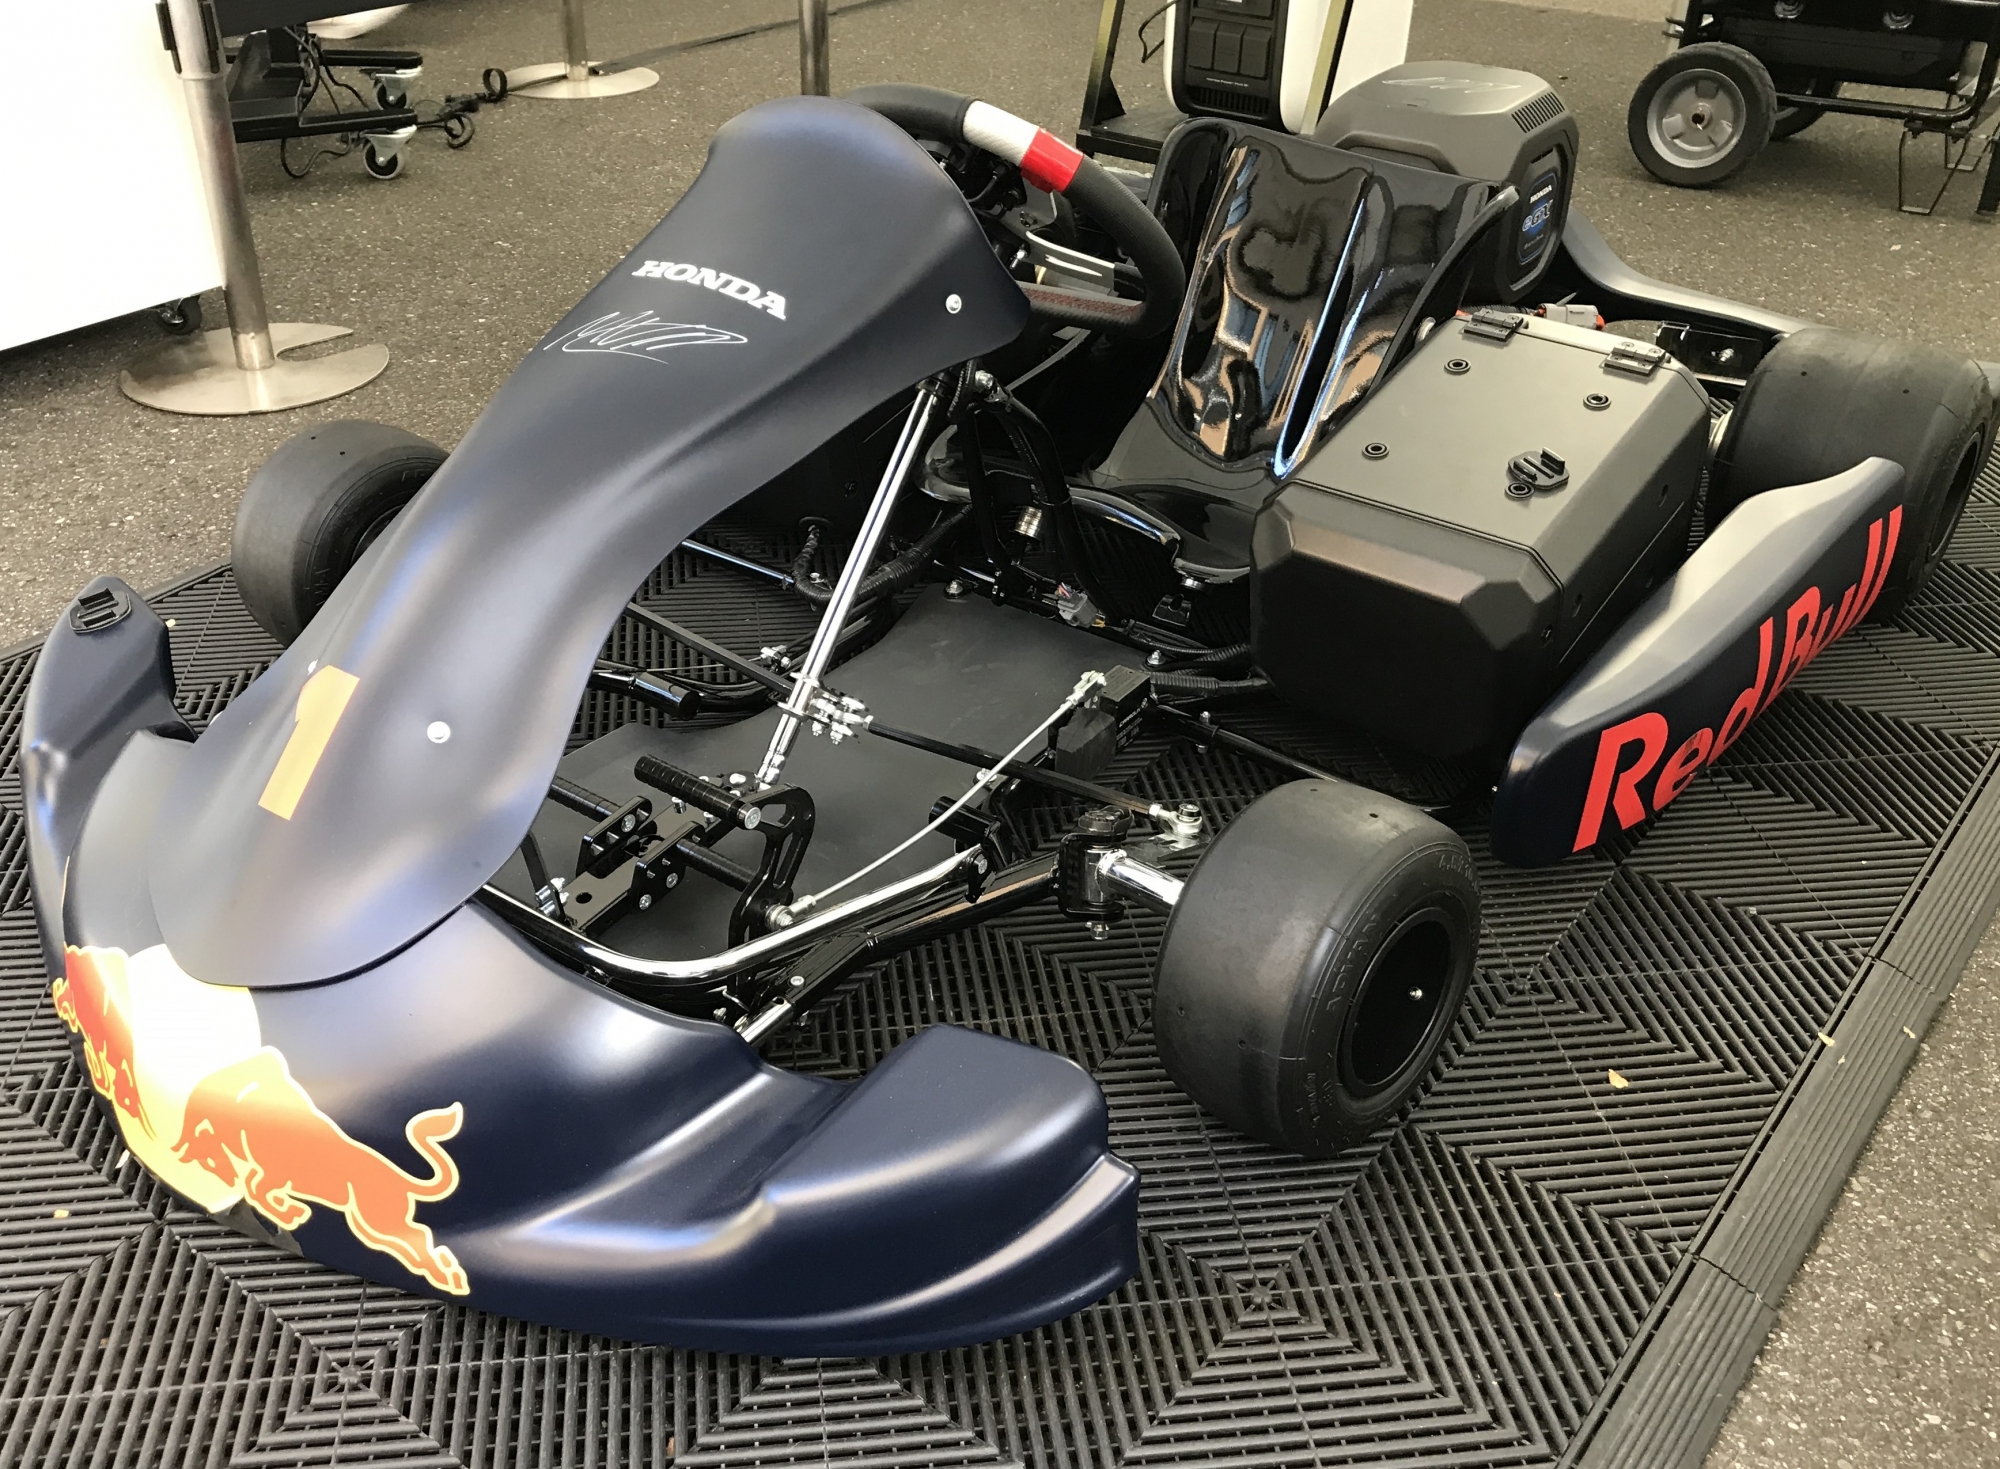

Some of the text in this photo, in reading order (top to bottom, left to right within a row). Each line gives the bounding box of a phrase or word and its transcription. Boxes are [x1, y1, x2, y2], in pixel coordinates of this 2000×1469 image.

[1529, 184, 1553, 204] HONDA
[631, 260, 788, 321] HONDA
[1572, 504, 1903, 853] Red Bull
[258, 664, 360, 821] 1
